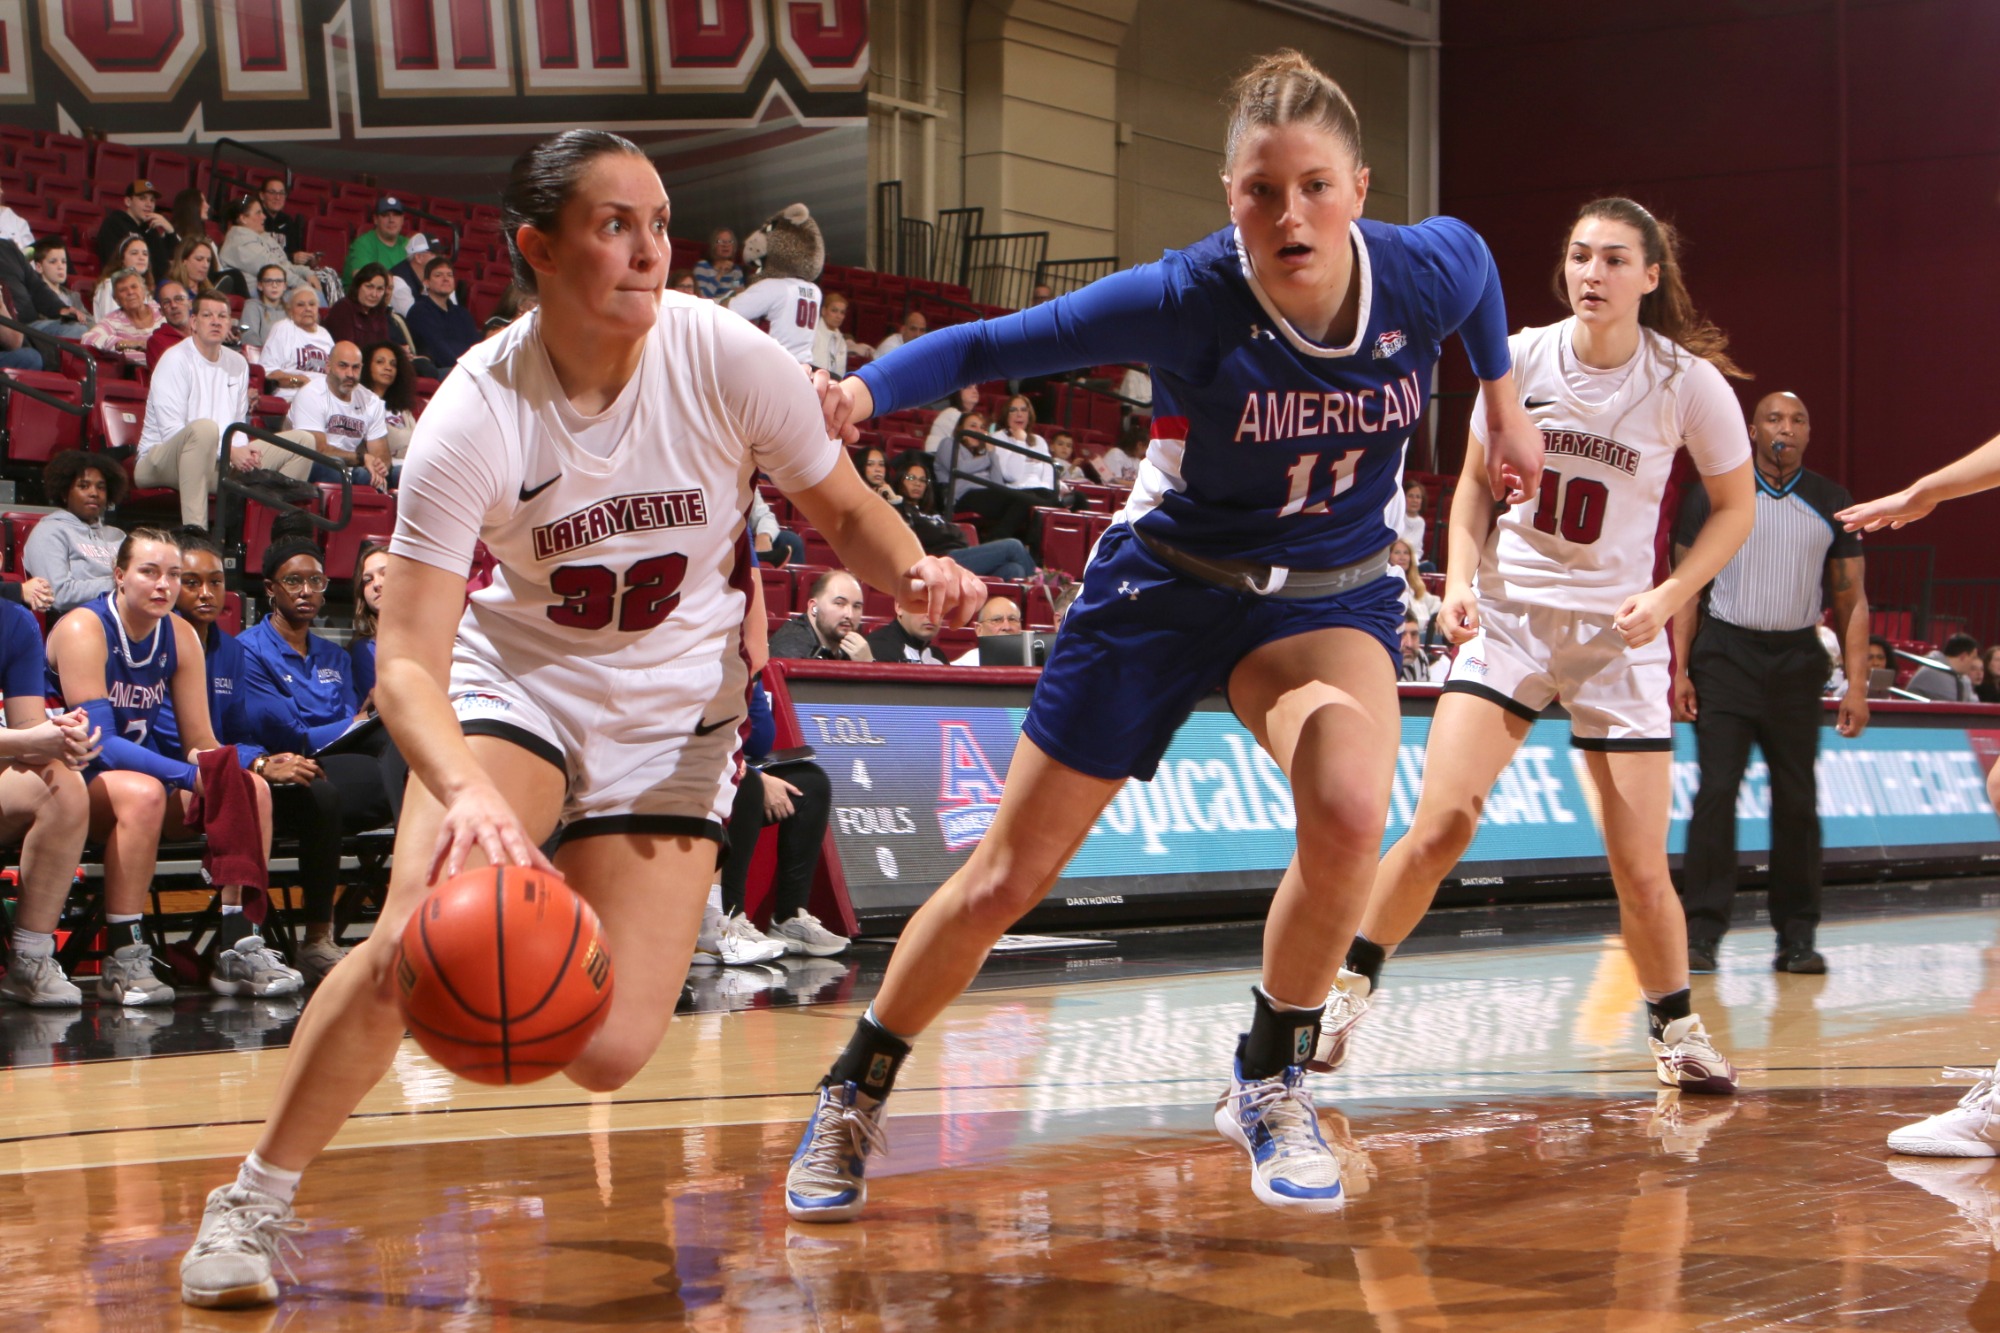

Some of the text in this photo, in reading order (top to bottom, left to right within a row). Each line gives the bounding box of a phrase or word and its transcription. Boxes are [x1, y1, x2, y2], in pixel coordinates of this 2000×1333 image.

[1234, 371, 1422, 443] AMERICAN
[1277, 448, 1367, 518] 11
[1543, 430, 1640, 475] AFAYETTE
[533, 489, 708, 560] LAFAYETTE
[1533, 468, 1609, 545] 10
[546, 552, 688, 632] 32
[851, 758, 873, 791] 4
[937, 719, 1005, 804] A
[835, 806, 917, 835] FOULS
[1066, 895, 1124, 907] DAKTRONICS
[1461, 876, 1504, 887] DAKTRONICS
